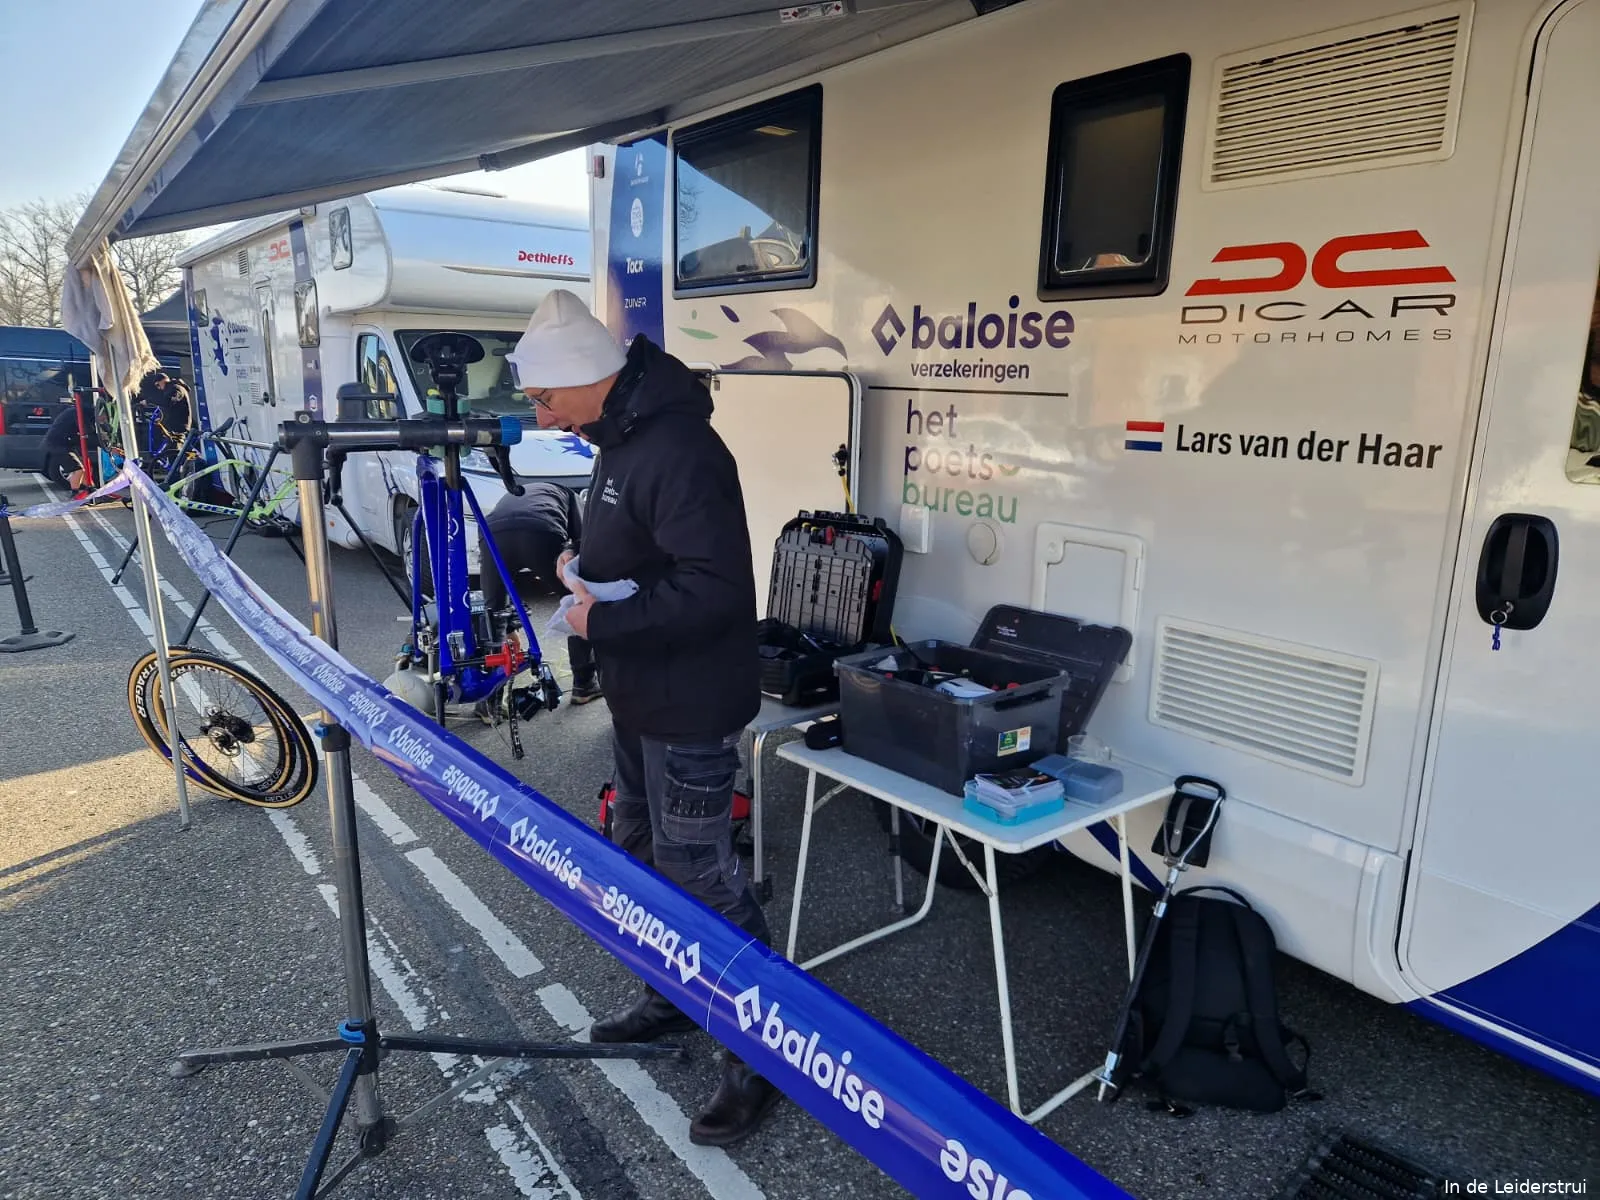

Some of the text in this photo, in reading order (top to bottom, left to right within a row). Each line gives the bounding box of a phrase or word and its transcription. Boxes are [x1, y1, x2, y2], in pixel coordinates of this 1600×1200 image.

[518, 250, 574, 266] Dethleffs
[911, 294, 1075, 350] baloise
[1181, 294, 1457, 325] DICAR
[1178, 328, 1452, 345] MOTORHOMES
[911, 358, 1030, 384] verzekeringen
[906, 399, 958, 439] het
[903, 443, 994, 481] poets
[1176, 424, 1443, 469] Lars van der Haar
[902, 474, 1018, 524] bureau
[396, 729, 434, 770] baloise
[442, 764, 491, 822] baloise
[524, 822, 582, 890] baloise
[602, 886, 682, 969] baloise
[761, 1002, 885, 1129] baloise
[940, 1139, 1034, 1200] ise
